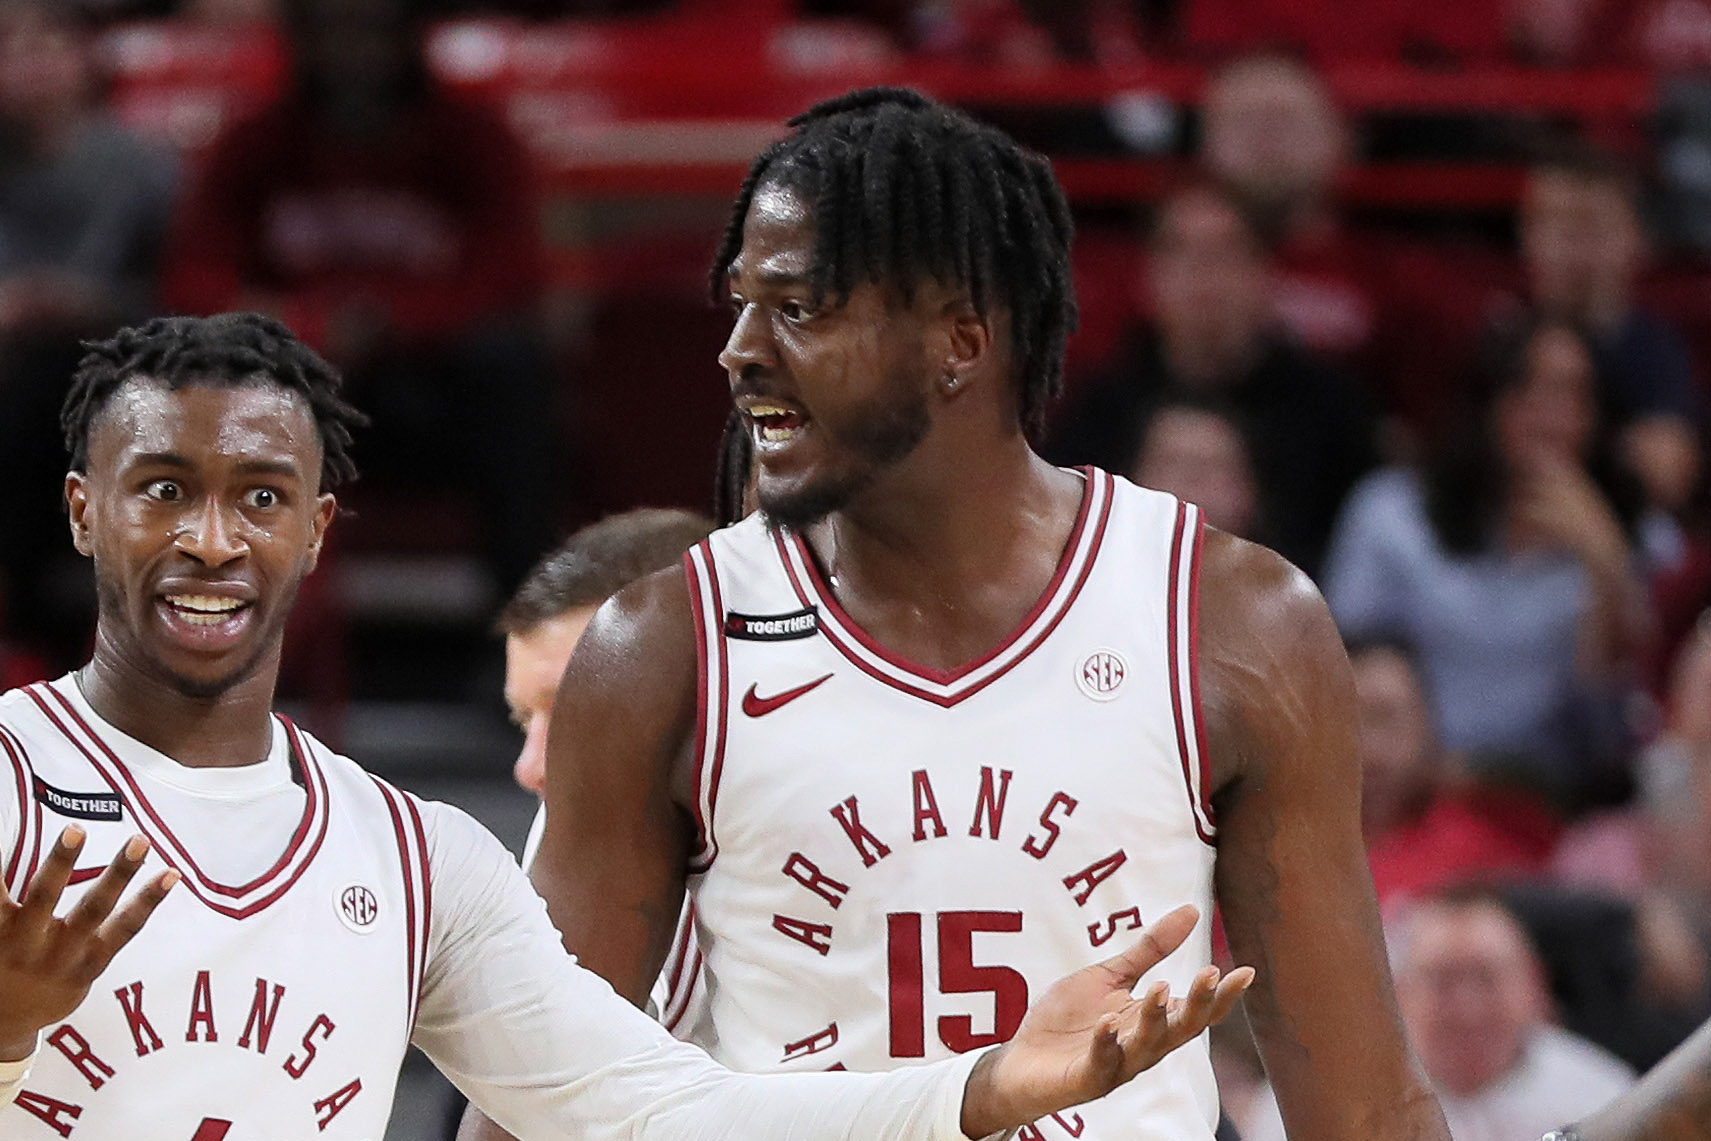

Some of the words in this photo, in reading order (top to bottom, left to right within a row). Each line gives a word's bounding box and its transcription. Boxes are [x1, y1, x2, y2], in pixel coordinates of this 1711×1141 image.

[745, 613, 816, 635] TOGETHER
[1083, 652, 1123, 692] SEC
[46, 788, 121, 814] TOGETHER
[772, 766, 1142, 956] ARKANSAS
[341, 886, 377, 925] SEC
[887, 909, 1029, 1058] 15
